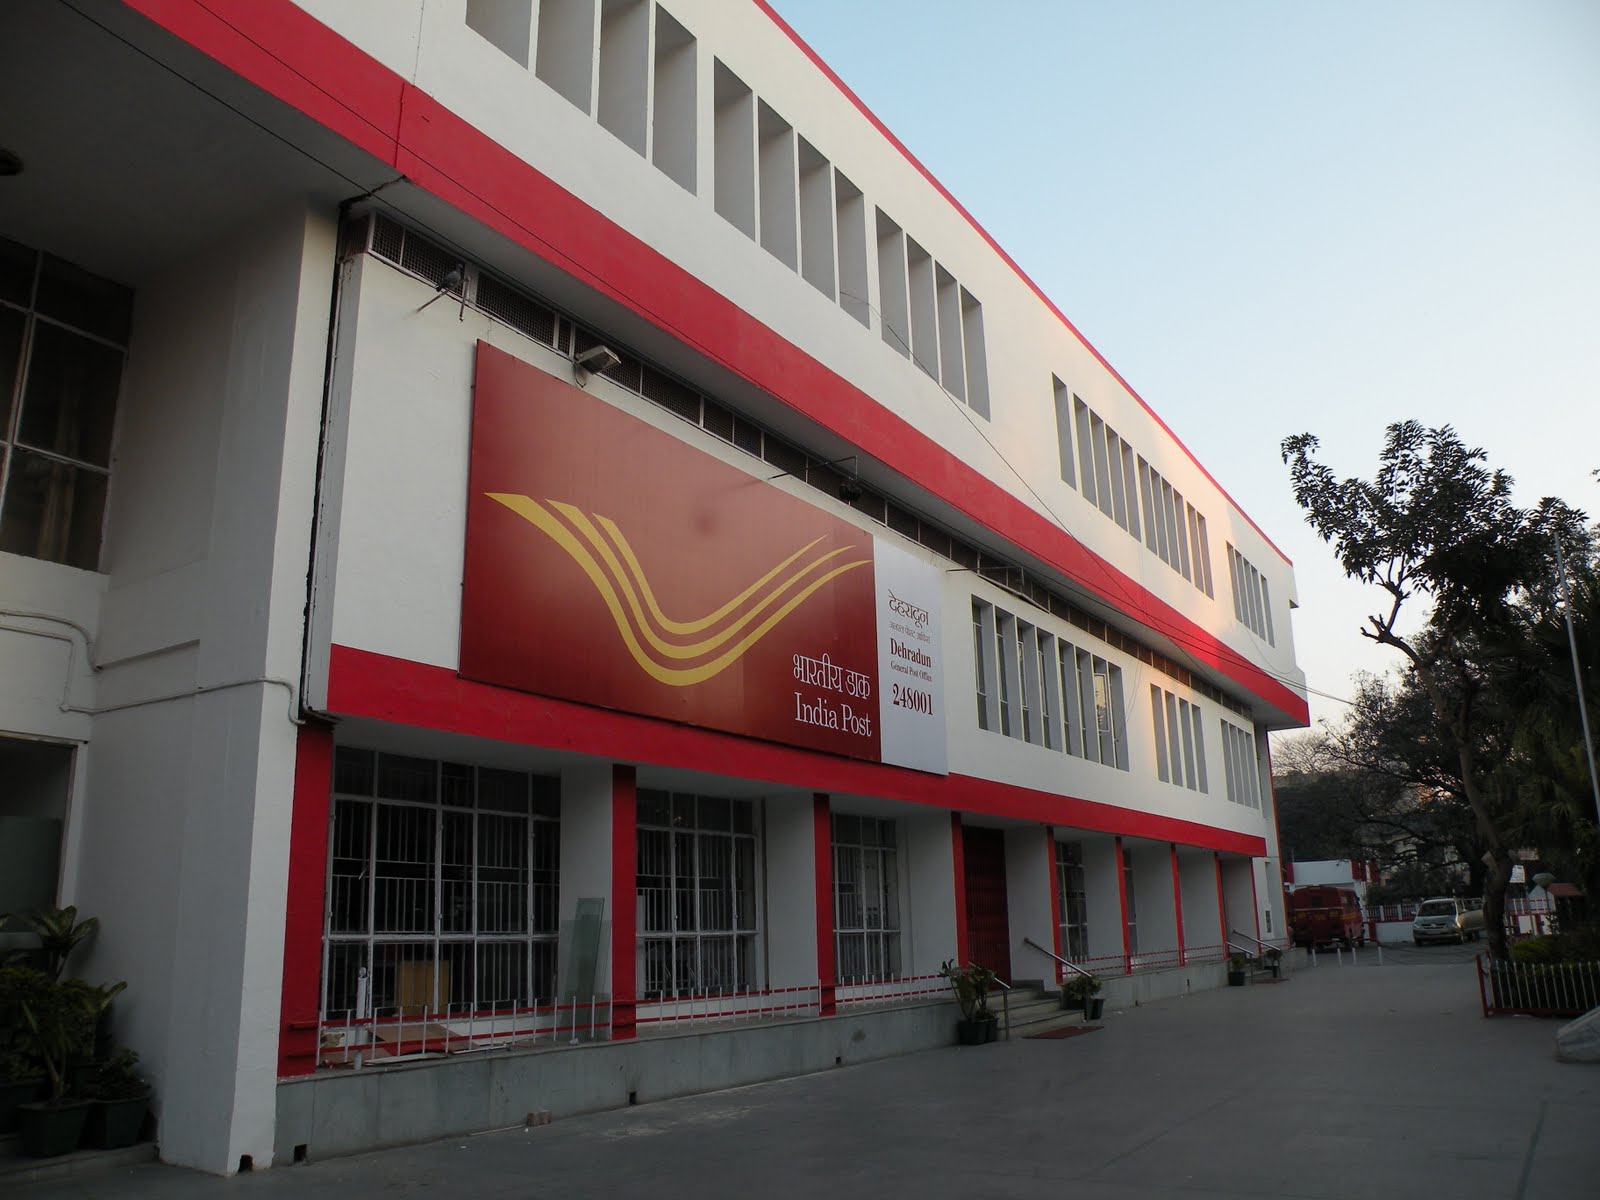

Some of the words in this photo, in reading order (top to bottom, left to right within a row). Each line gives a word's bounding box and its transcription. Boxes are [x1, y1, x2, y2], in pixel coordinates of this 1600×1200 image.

[888, 589, 929, 629] देहरादून
[890, 637, 932, 668] Dehradun
[793, 652, 843, 693] भारतीय
[845, 668, 871, 700] डाक
[890, 660, 908, 675] General
[909, 667, 919, 678] Post
[919, 670, 933, 683] Office
[794, 691, 839, 731] India
[841, 703, 872, 738] Post
[892, 683, 934, 716] 248001
